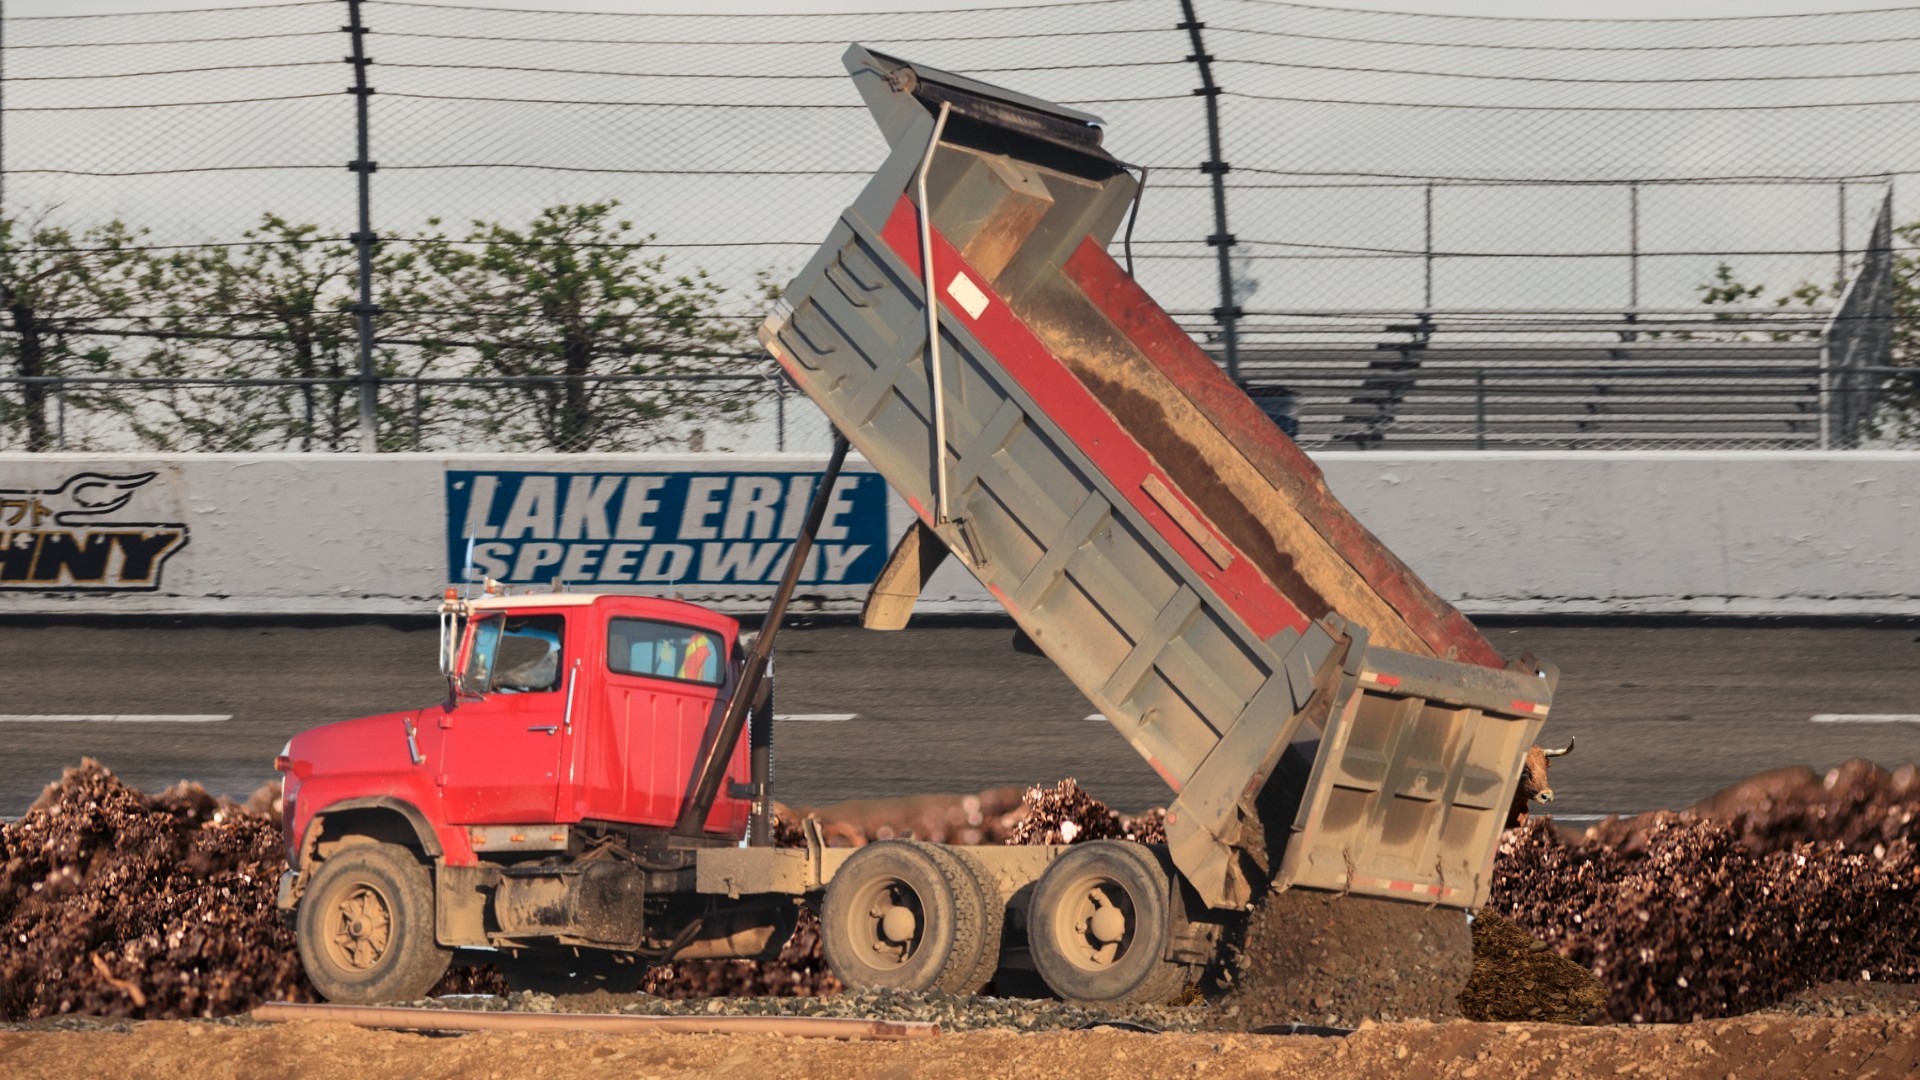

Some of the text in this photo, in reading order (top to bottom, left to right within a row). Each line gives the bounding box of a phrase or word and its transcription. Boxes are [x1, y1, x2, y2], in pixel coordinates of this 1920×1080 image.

[461, 475, 861, 540] LAKE ERIE
[461, 542, 872, 582] SPEEDWAY
